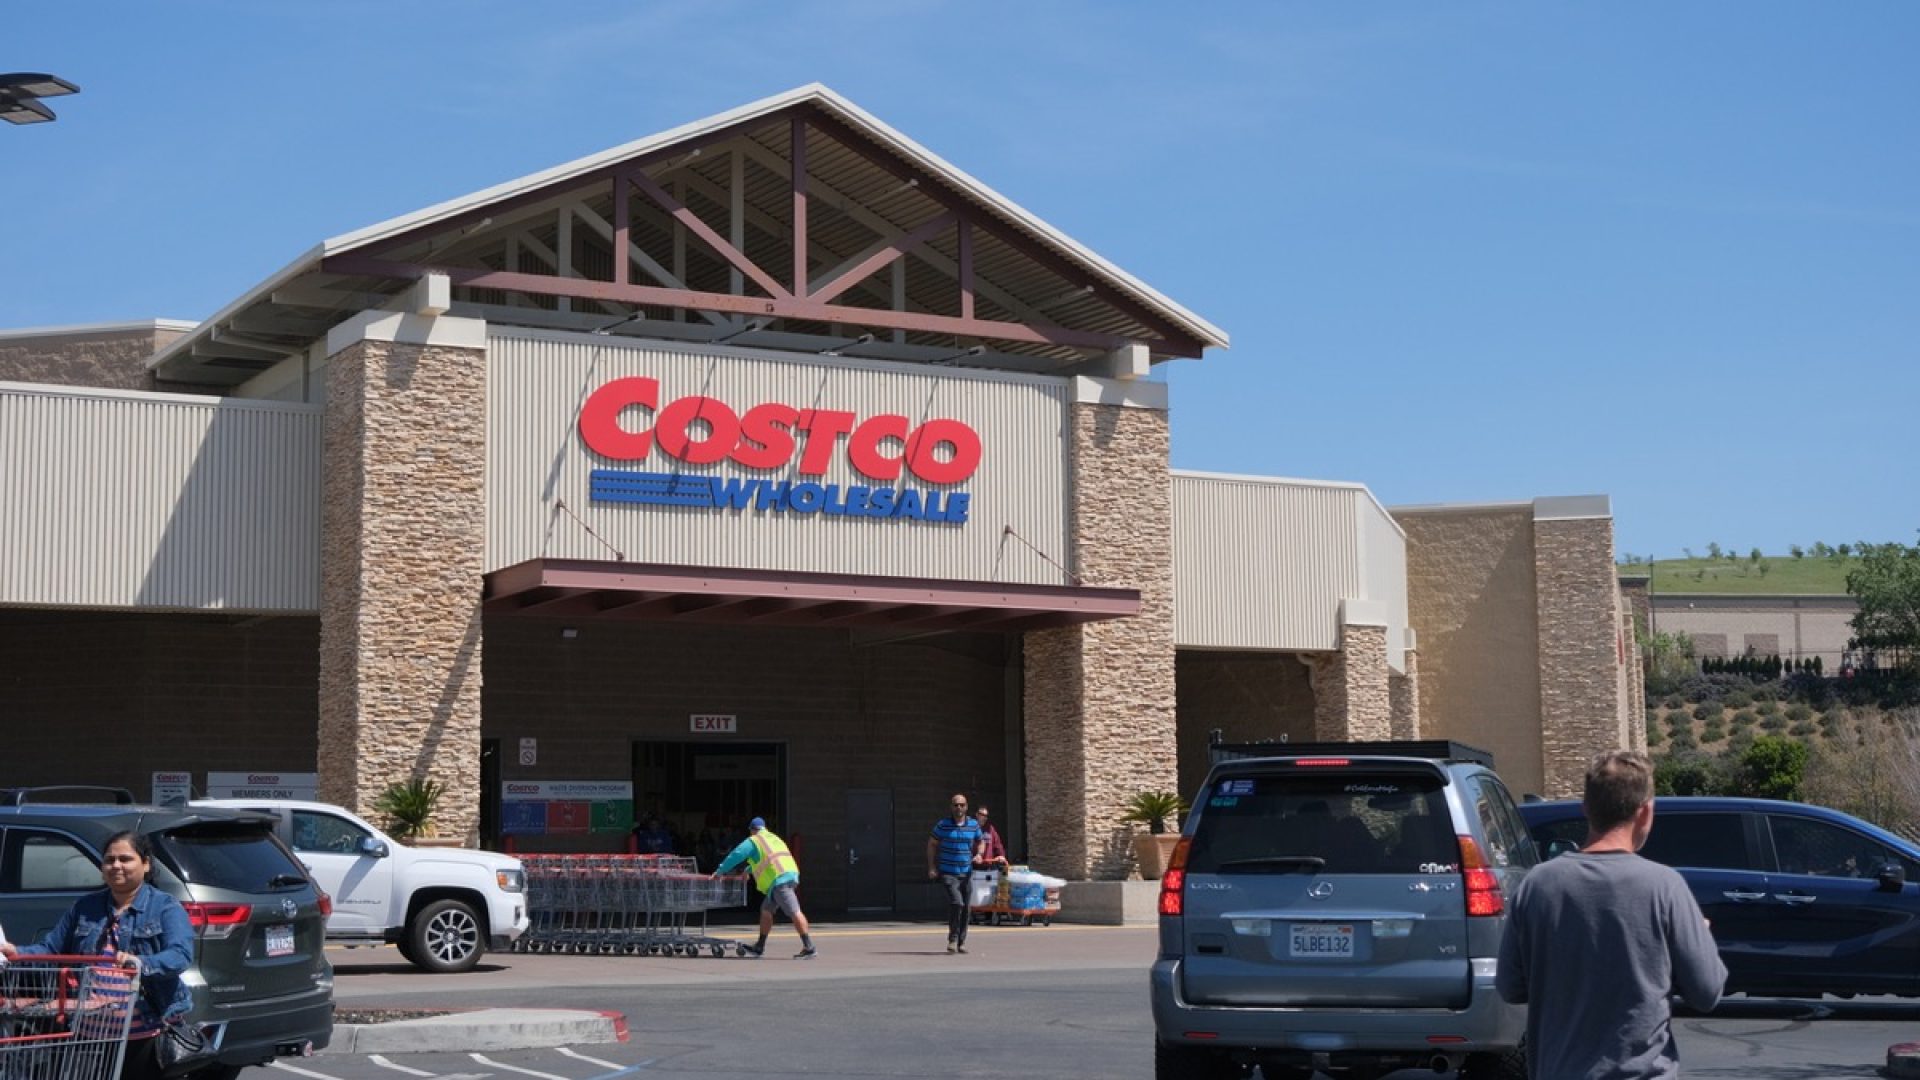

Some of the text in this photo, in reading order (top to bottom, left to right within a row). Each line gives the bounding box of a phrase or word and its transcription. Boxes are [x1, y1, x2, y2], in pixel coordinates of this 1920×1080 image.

[579, 376, 982, 484] COSTCO
[709, 476, 971, 524] WHOLESALE
[695, 716, 731, 730] EXIT
[232, 789, 294, 799] MEMBERS ONLY
[1294, 935, 1350, 953] 5LBE132
